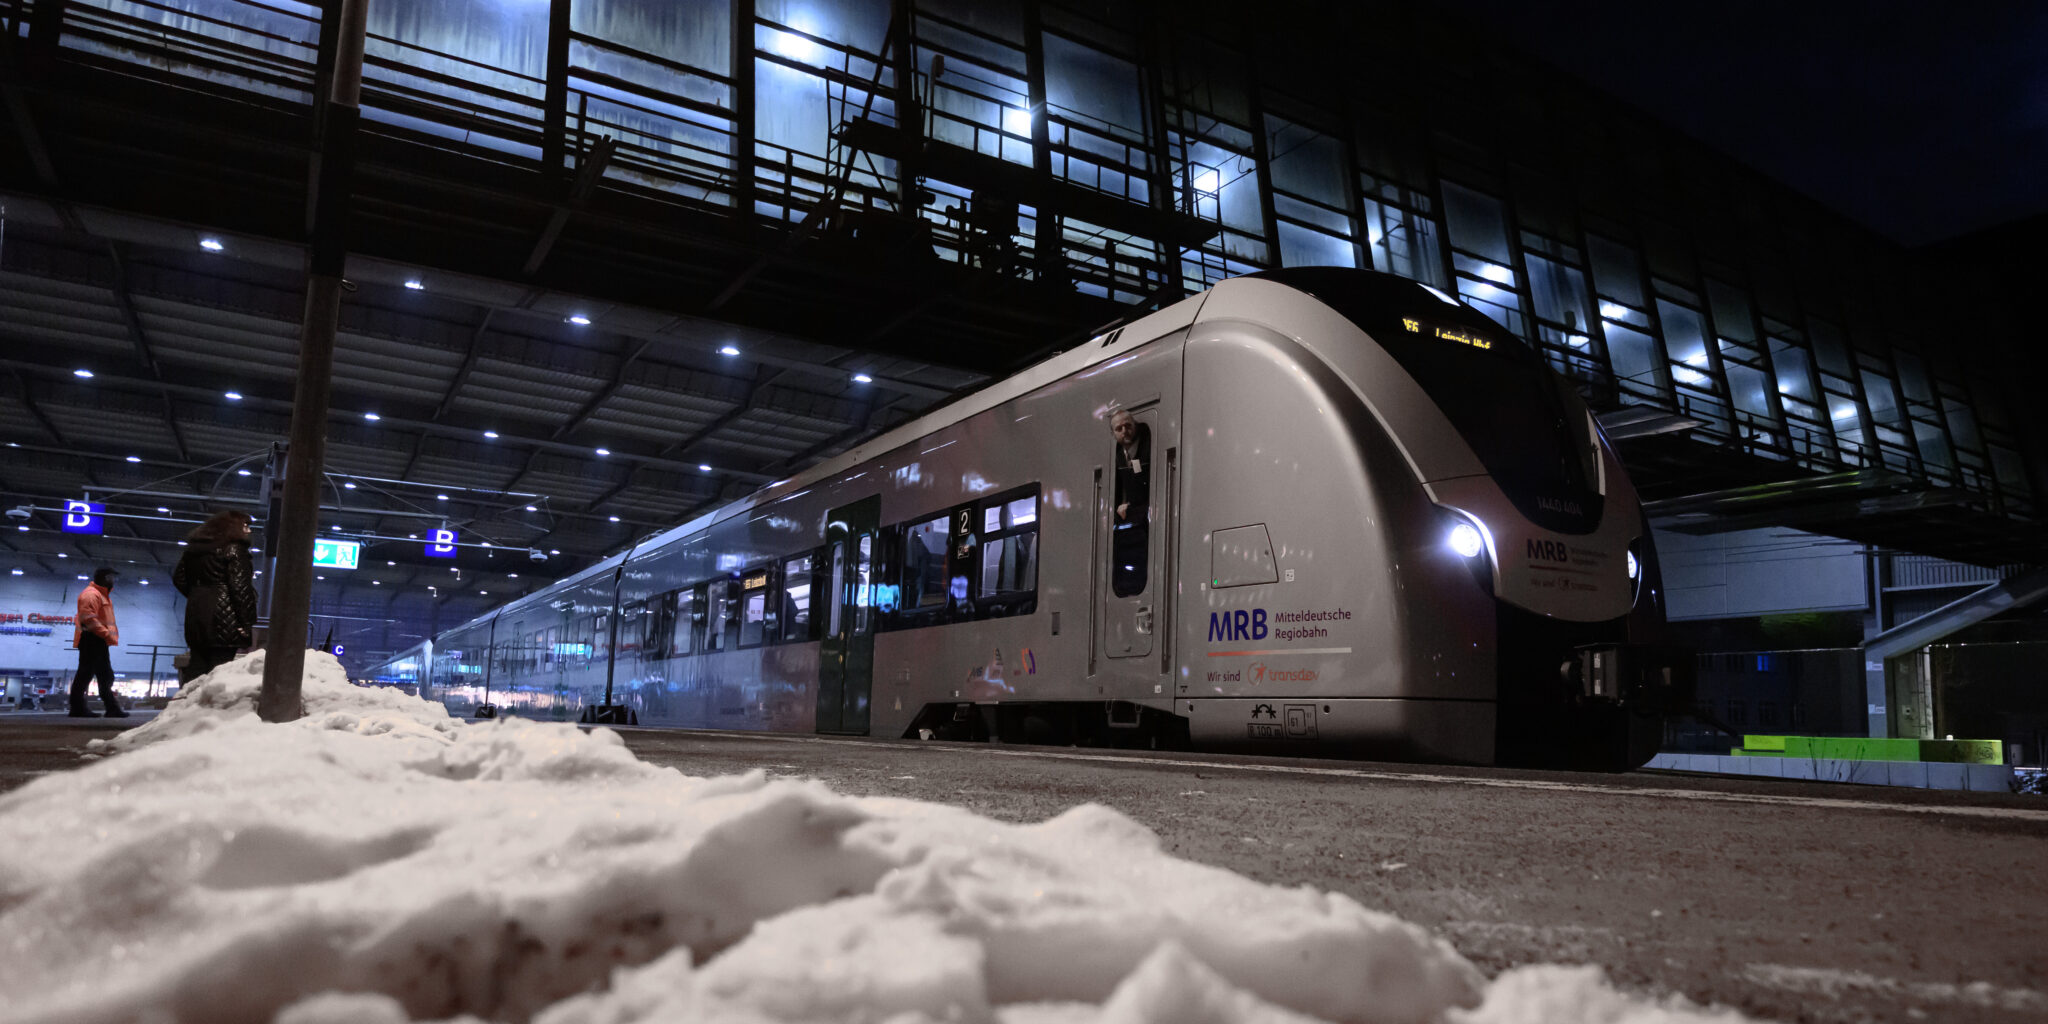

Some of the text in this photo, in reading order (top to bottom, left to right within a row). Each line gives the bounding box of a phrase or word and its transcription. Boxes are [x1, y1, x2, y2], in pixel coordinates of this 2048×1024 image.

[67, 502, 90, 527] B
[961, 511, 969, 534] 2
[435, 529, 454, 552] B
[1527, 539, 1567, 562] MRB
[1275, 607, 1352, 623] Mitteldeutsche
[1208, 608, 1268, 642] MRB
[1275, 625, 1328, 641] Regiobahn
[335, 645, 344, 655] C
[1207, 668, 1321, 682] Wir sind transdev
[1257, 725, 1272, 737] 100
